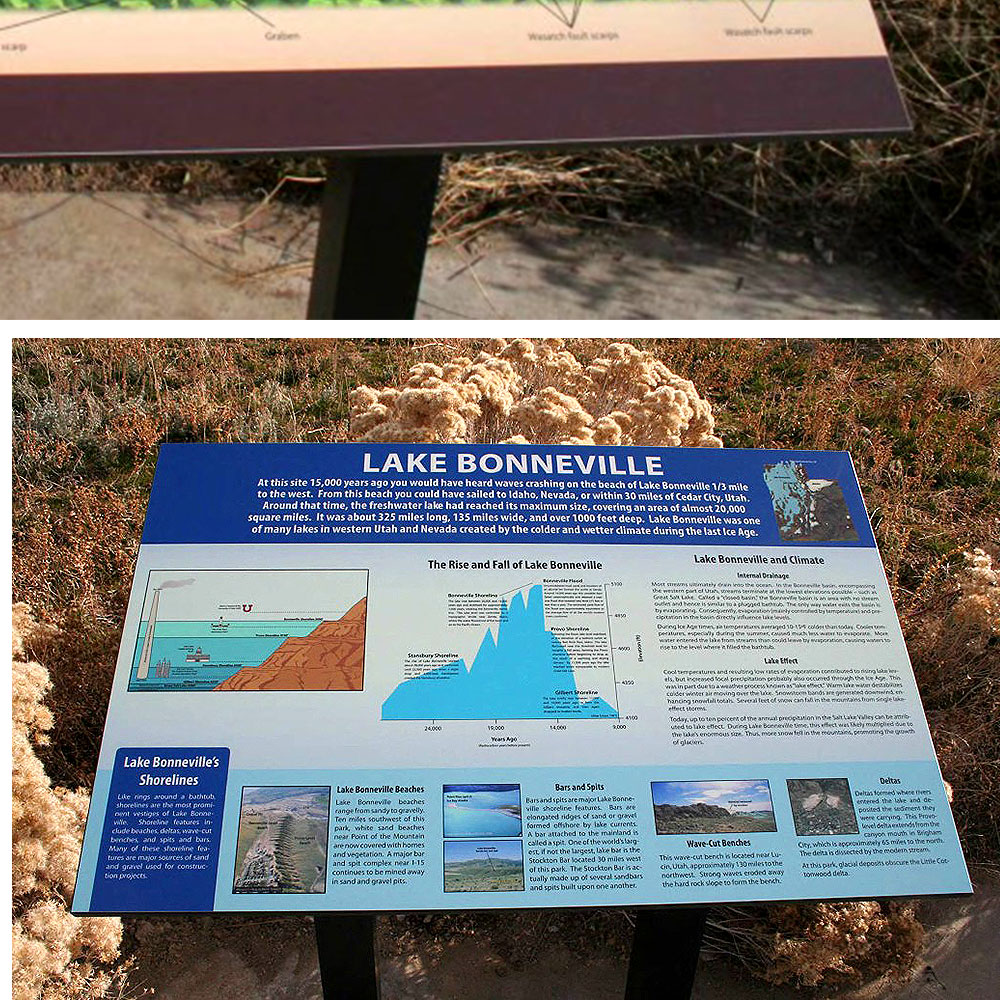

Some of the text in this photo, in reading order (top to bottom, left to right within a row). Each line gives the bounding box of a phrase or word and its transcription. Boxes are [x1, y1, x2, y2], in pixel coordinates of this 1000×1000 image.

[264, 32, 301, 41] Graben
[363, 453, 664, 476] LAKE BONNEVILLE
[257, 479, 269, 487] At
[270, 478, 289, 487] this
[290, 478, 308, 487] site
[310, 478, 342, 488] 15,000
[344, 480, 369, 489] years
[370, 480, 389, 489] ago
[390, 480, 407, 489] you
[409, 478, 439, 487] would
[441, 478, 464, 487] have
[465, 478, 493, 487] heard
[526, 479, 565, 490] crashing
[580, 480, 597, 489] the
[598, 480, 626, 489] beach
[627, 480, 637, 489] of
[639, 481, 661, 490] Lake
[662, 481, 710, 491] Bonneville
[712, 482, 727, 491] 1/3
[728, 483, 749, 491] mile
[694, 554, 825, 565] Lake Bonneville and Climate
[428, 560, 603, 570] The Rise and Fall of Lake Bonneville
[762, 572, 789, 580] Drainage
[780, 657, 799, 665] Effect
[124, 756, 219, 768] Lake Bonneville's
[139, 774, 199, 786] Shorelines
[879, 777, 901, 785] Deltas
[337, 785, 424, 794] Lake Bonneville Beaches
[555, 783, 605, 793] Bars and Spits
[686, 838, 751, 848] Wave-Cut Benches
